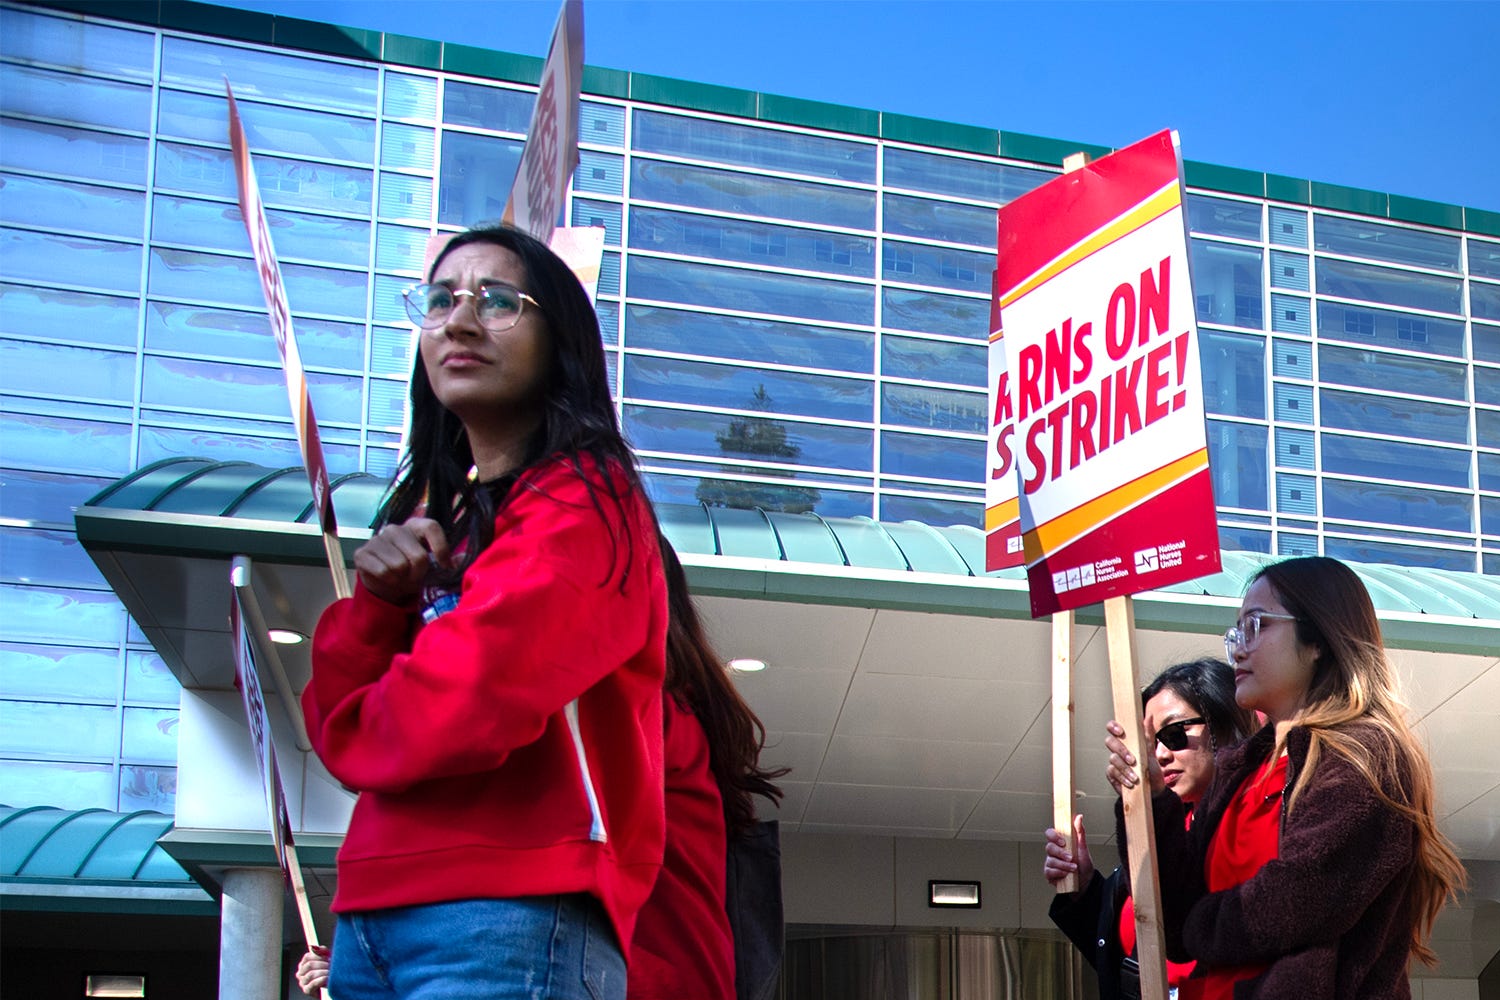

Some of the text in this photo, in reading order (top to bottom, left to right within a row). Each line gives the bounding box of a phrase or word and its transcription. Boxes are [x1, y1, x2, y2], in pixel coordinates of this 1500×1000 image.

[1018, 317, 1092, 423] RNs
[1104, 255, 1171, 361] ON
[1024, 331, 1190, 494] STRIKE!
[1158, 540, 1186, 554] National
[1160, 550, 1182, 561] Nurses
[1095, 556, 1122, 570] California
[1160, 557, 1182, 569] United
[1096, 566, 1115, 576] Nurses
[1096, 569, 1129, 583] Association
